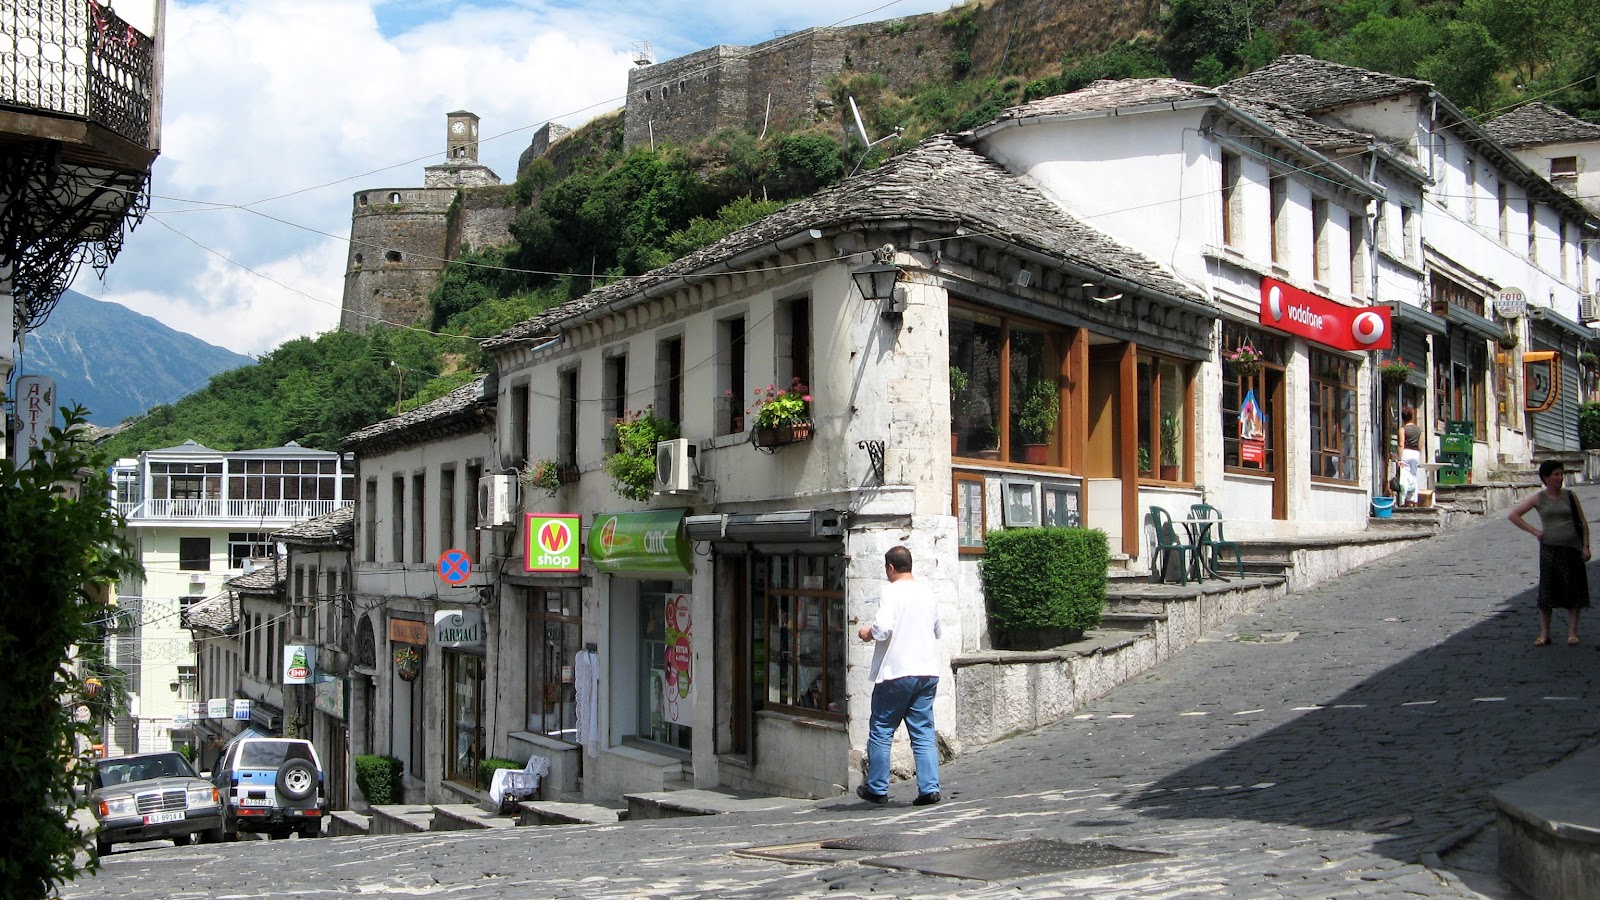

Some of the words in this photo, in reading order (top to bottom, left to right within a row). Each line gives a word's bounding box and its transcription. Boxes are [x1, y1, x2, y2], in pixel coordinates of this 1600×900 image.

[1500, 293, 1522, 301] FOTO
[1287, 304, 1323, 330] vodafone
[643, 529, 669, 554] amc
[537, 552, 572, 569] shop
